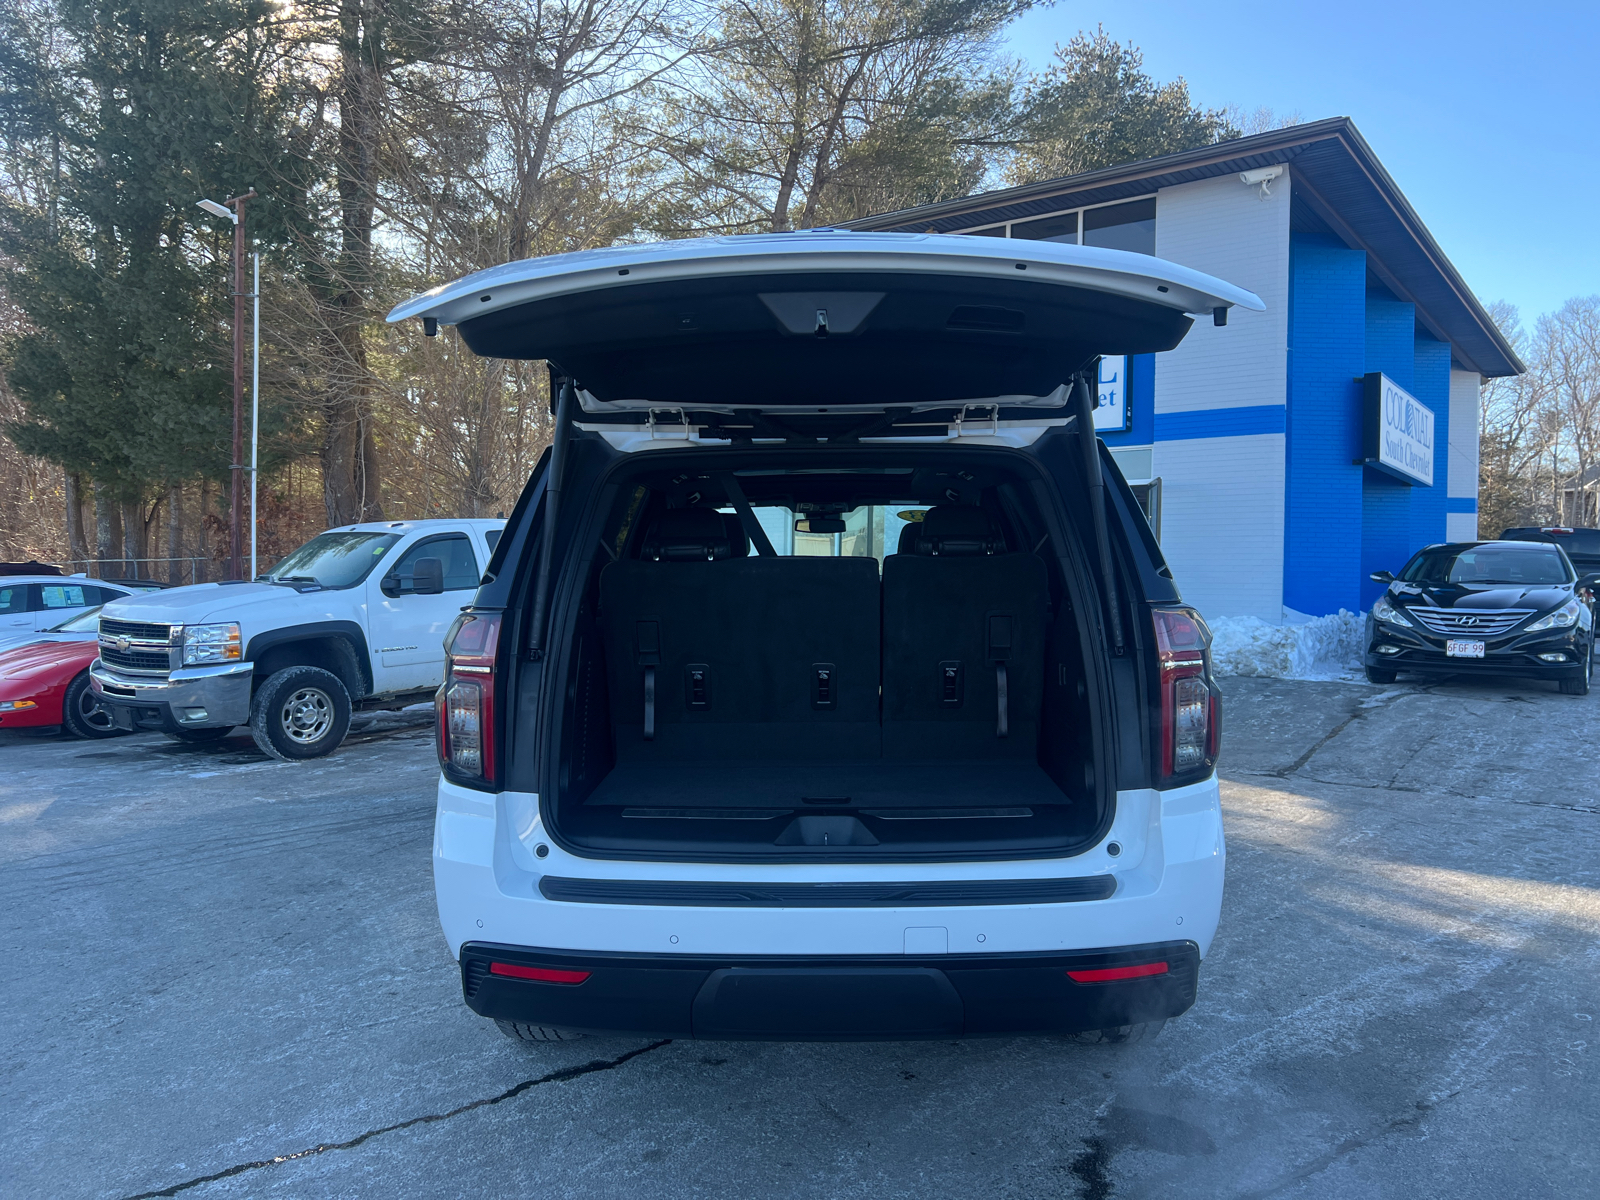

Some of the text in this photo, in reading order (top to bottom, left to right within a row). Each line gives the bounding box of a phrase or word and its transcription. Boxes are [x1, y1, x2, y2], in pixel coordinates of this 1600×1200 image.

[1386, 387, 1431, 450] COLONIAL
[1385, 430, 1430, 477] South Chevrolet
[1447, 643, 1483, 653] 6FGF 99
